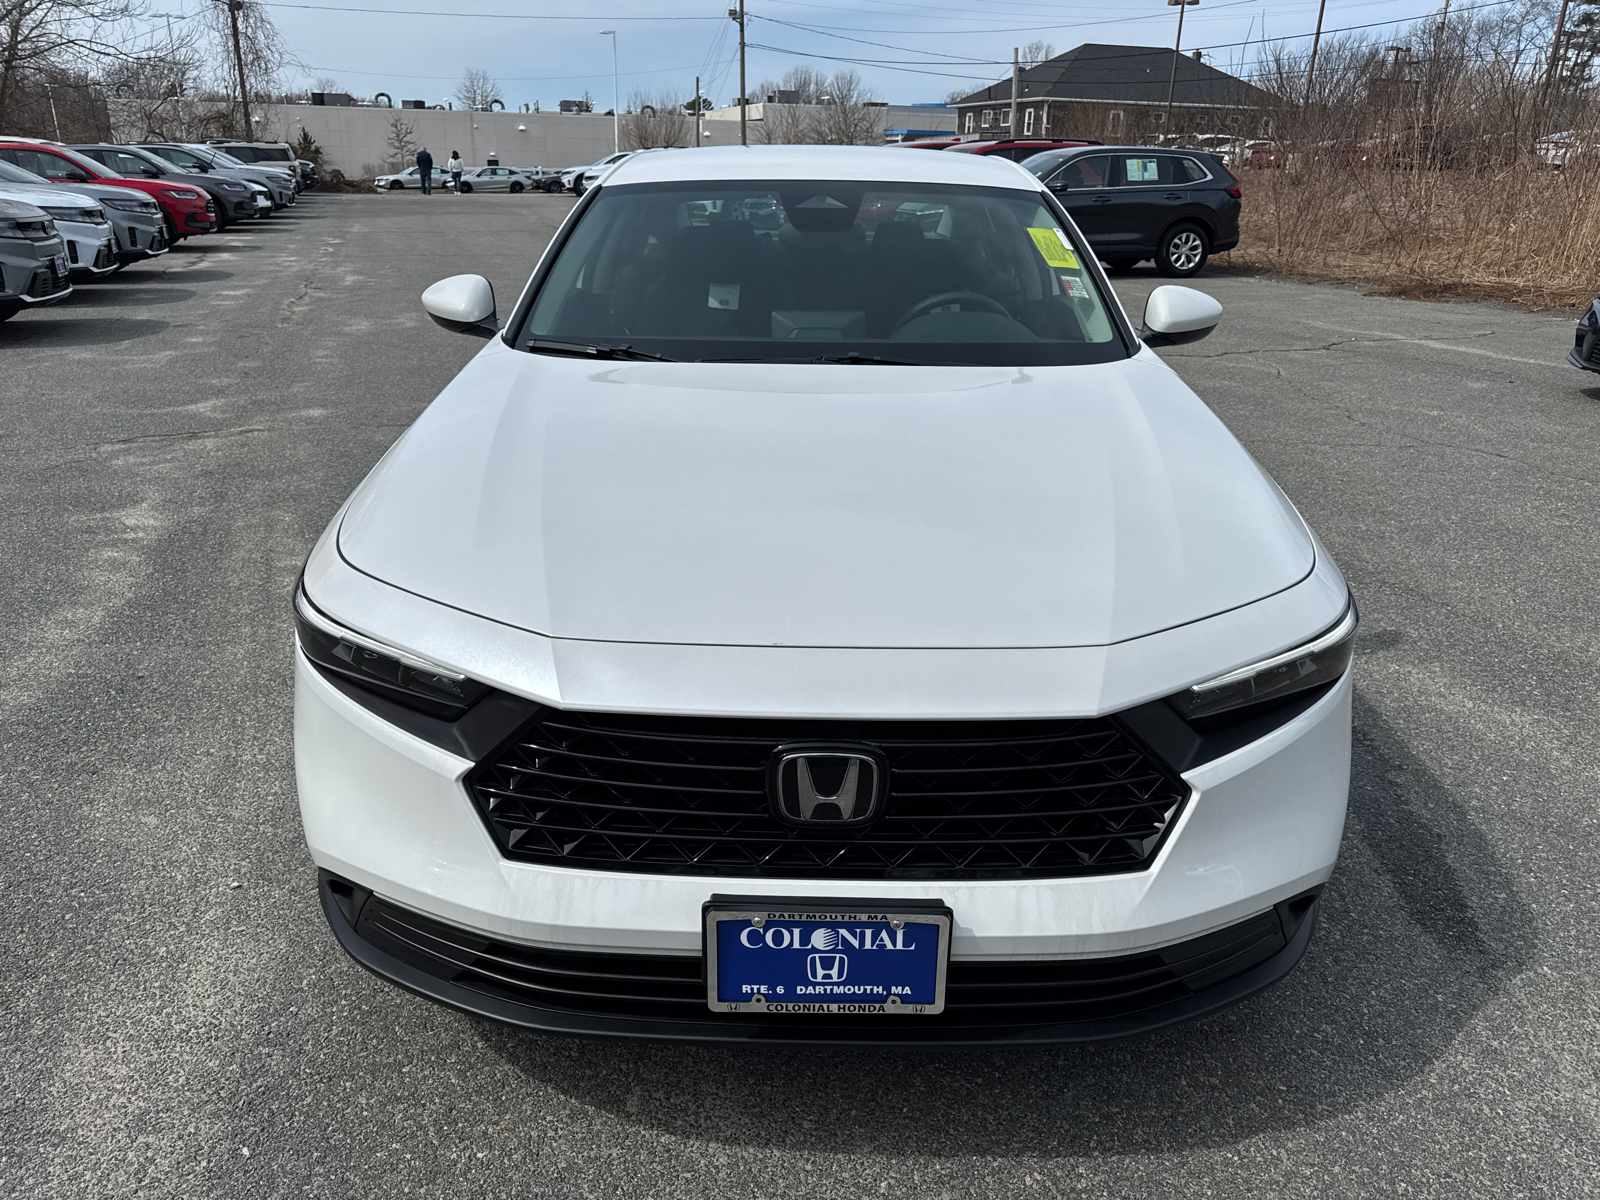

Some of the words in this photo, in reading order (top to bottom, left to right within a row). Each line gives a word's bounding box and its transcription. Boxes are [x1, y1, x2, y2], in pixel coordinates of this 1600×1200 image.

[767, 913, 861, 921] DARTMOUTH,
[740, 926, 916, 951] COLONIAL
[742, 984, 773, 994] RTE.
[776, 985, 785, 995] 6
[796, 985, 887, 996] DARTMOUTH,
[890, 985, 912, 995] MA
[766, 1003, 833, 1012] COLONIAL
[837, 1004, 886, 1013] HONDA
